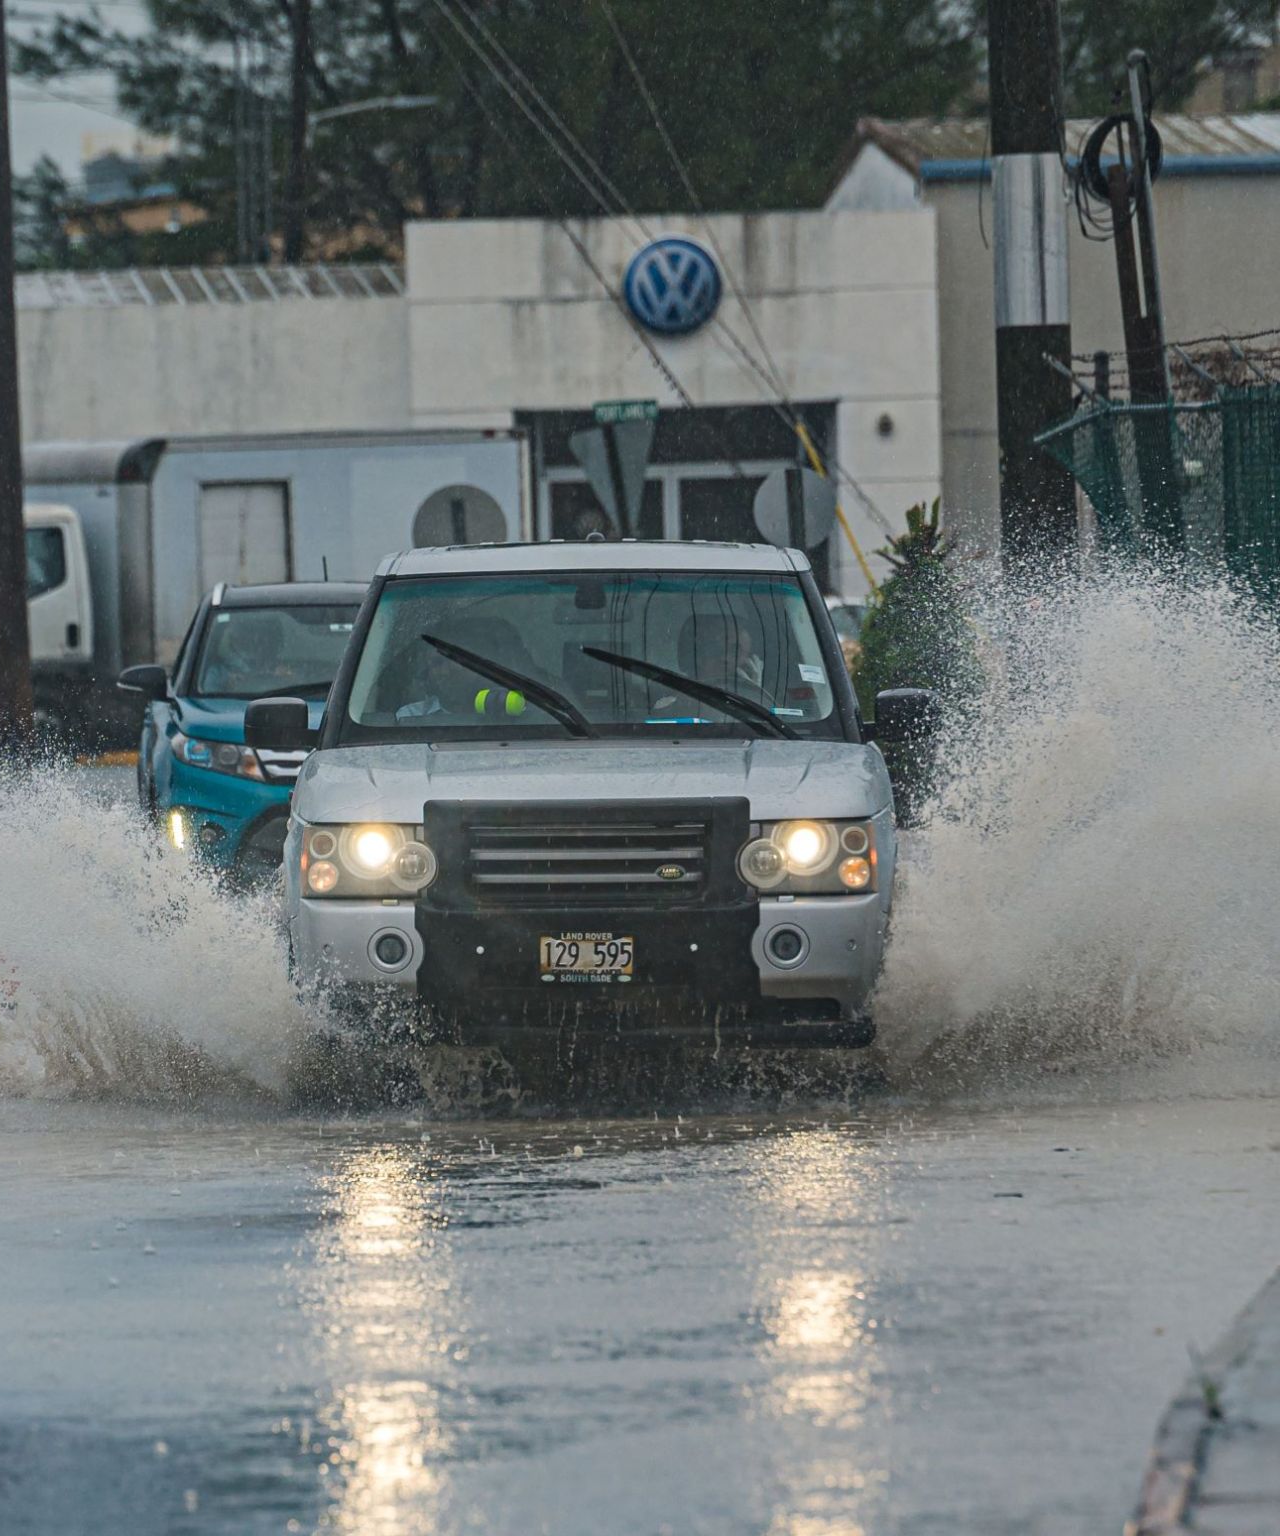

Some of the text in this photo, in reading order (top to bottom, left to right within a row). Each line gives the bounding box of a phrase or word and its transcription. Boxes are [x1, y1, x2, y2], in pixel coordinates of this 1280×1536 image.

[632, 246, 715, 326] VW
[560, 932, 613, 940] LAND ROVER
[545, 941, 632, 968] 129 595
[560, 975, 612, 983] SOUTH DADE
